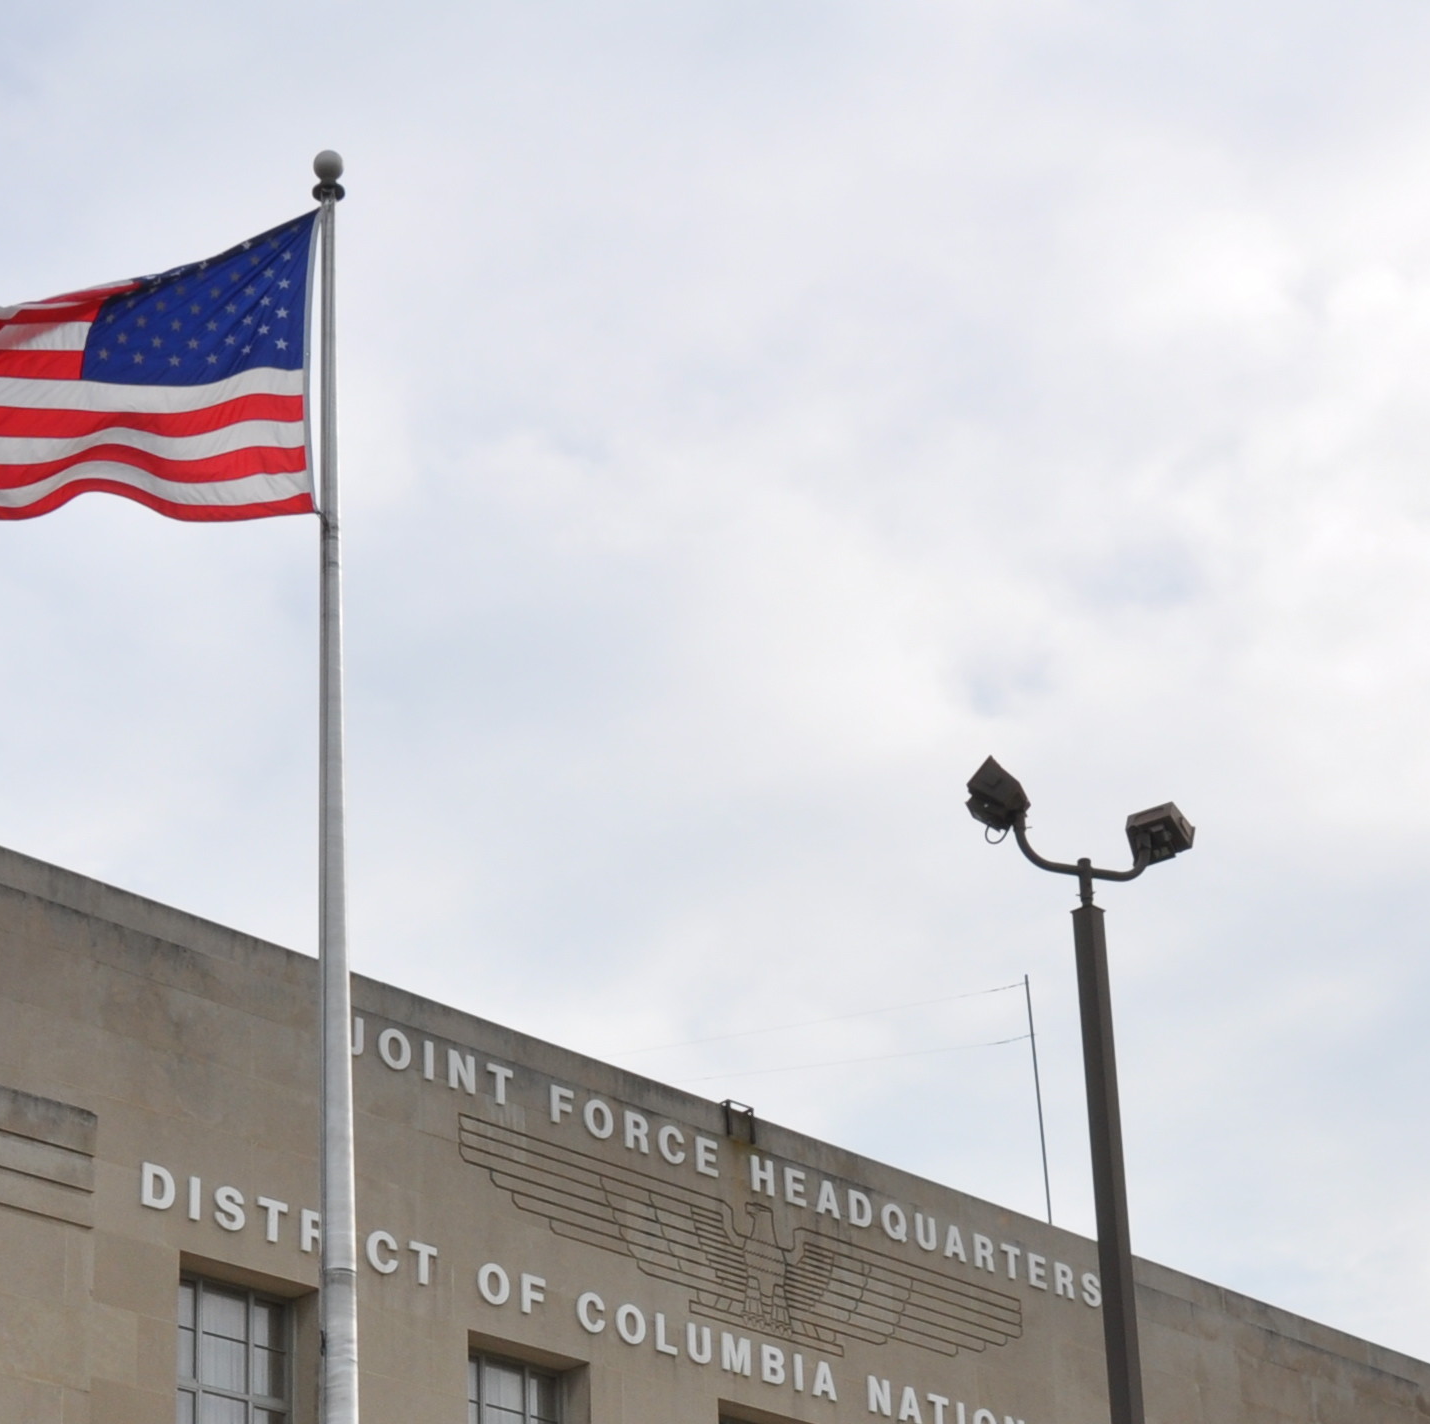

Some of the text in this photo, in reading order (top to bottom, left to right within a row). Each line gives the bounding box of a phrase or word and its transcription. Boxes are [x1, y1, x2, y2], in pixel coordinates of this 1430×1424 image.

[141, 1161, 438, 1286] DISTRCT
[477, 1262, 547, 1315] OF
[576, 1291, 838, 1402] COLUMBIA
[351, 1016, 1103, 1308] JOINT FORCE HEADQUARTERS
